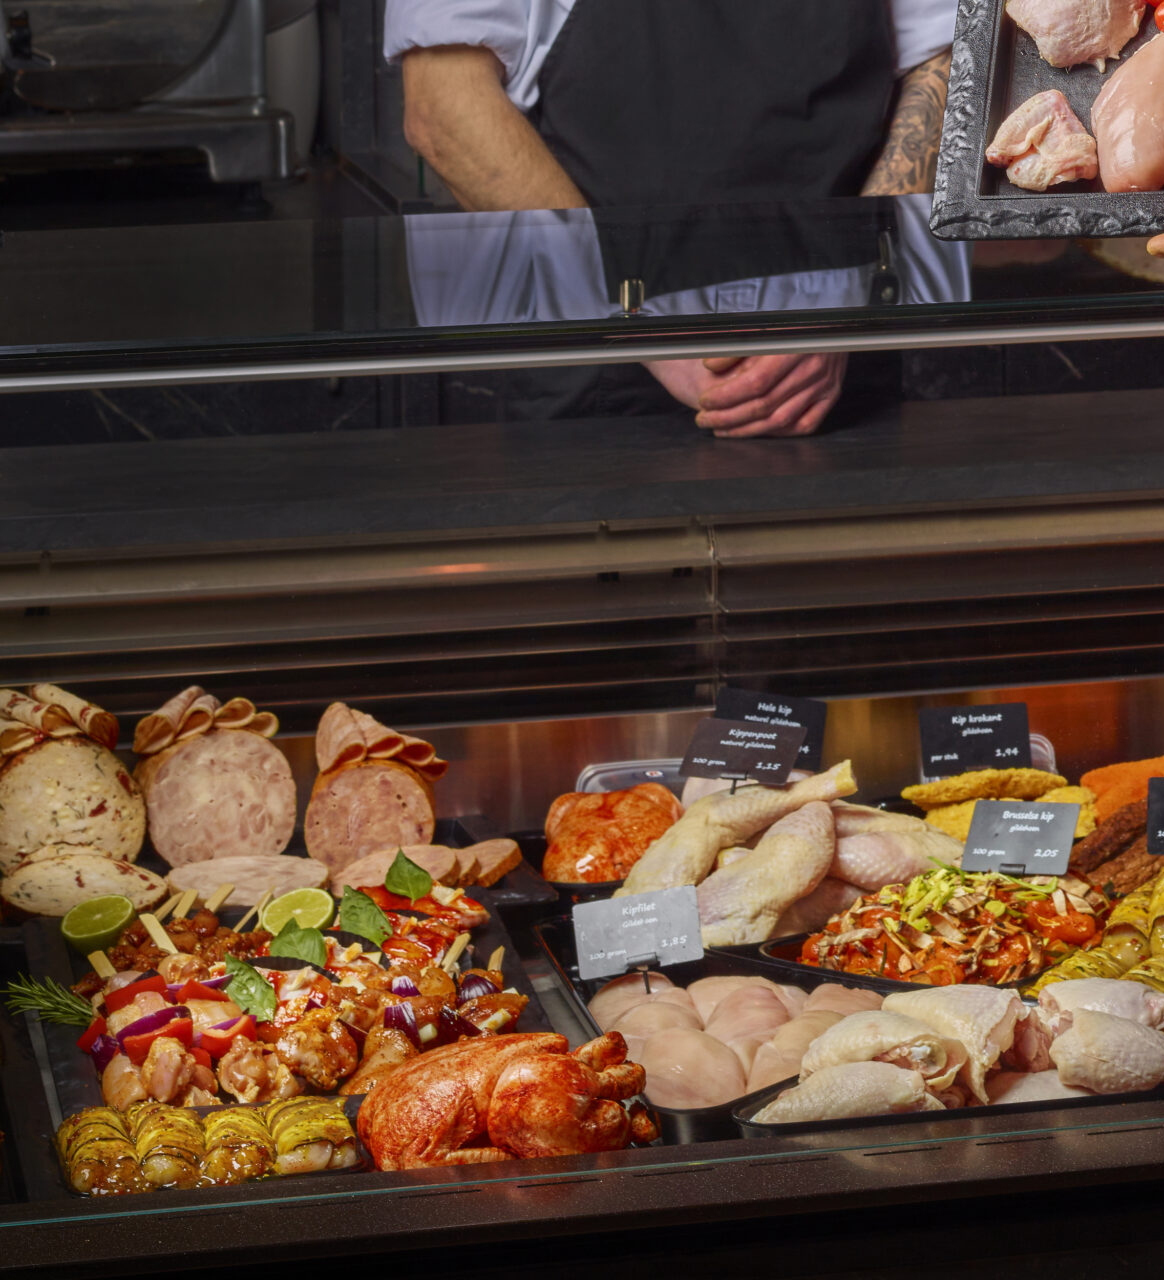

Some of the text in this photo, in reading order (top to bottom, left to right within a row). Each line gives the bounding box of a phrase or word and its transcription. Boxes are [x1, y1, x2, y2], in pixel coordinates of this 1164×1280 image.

[757, 702, 792, 717] Hele kip
[951, 713, 1003, 726] Kip krokant
[728, 729, 779, 740] Kippenpoot
[930, 753, 959, 763] per stuk
[1002, 810, 1055, 824] Brusselse kip
[987, 849, 1006, 857] gram
[1033, 848, 1059, 857] 2,05
[622, 902, 656, 917] Kipfilet
[661, 935, 688, 948] 1,85
[589, 952, 605, 961] 100
